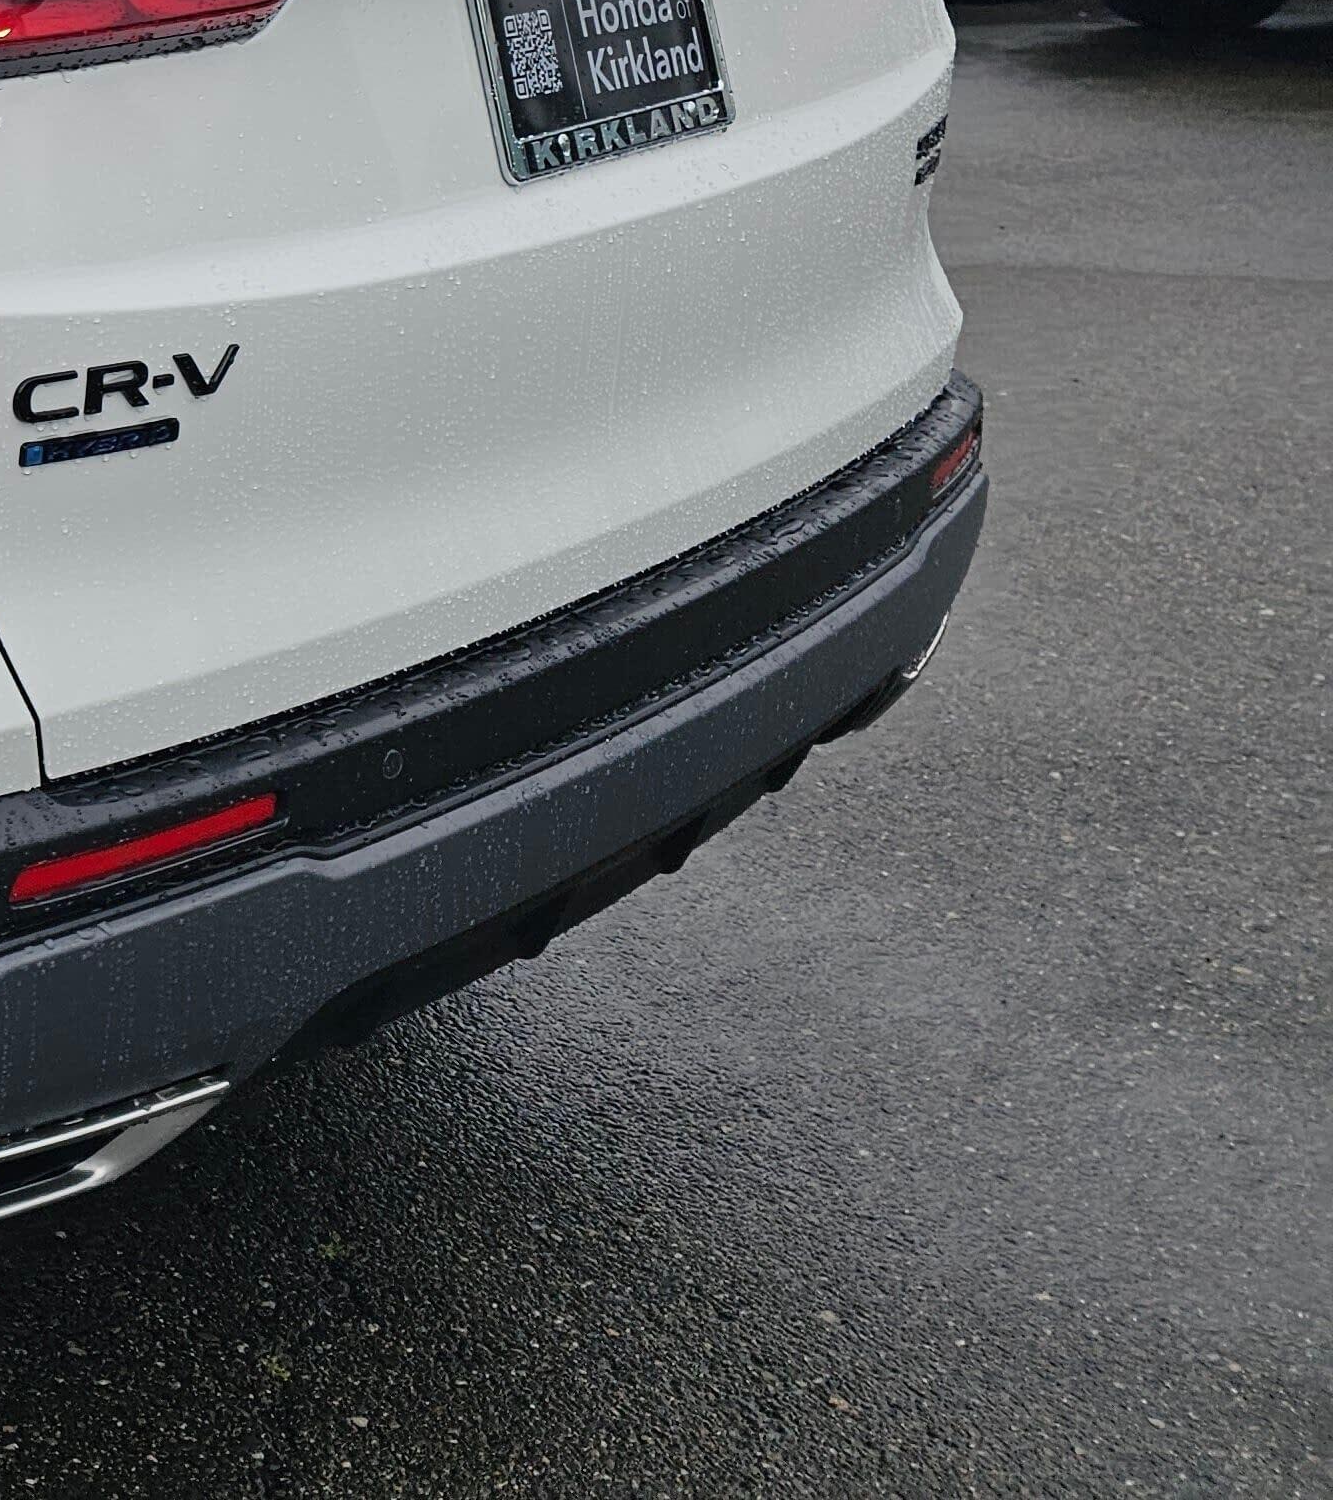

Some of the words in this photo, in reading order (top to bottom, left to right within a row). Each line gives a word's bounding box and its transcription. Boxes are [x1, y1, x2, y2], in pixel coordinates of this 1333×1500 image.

[587, 27, 704, 95] Kirkland
[531, 97, 720, 169] KIRKLAND
[12, 343, 241, 424] CR-V
